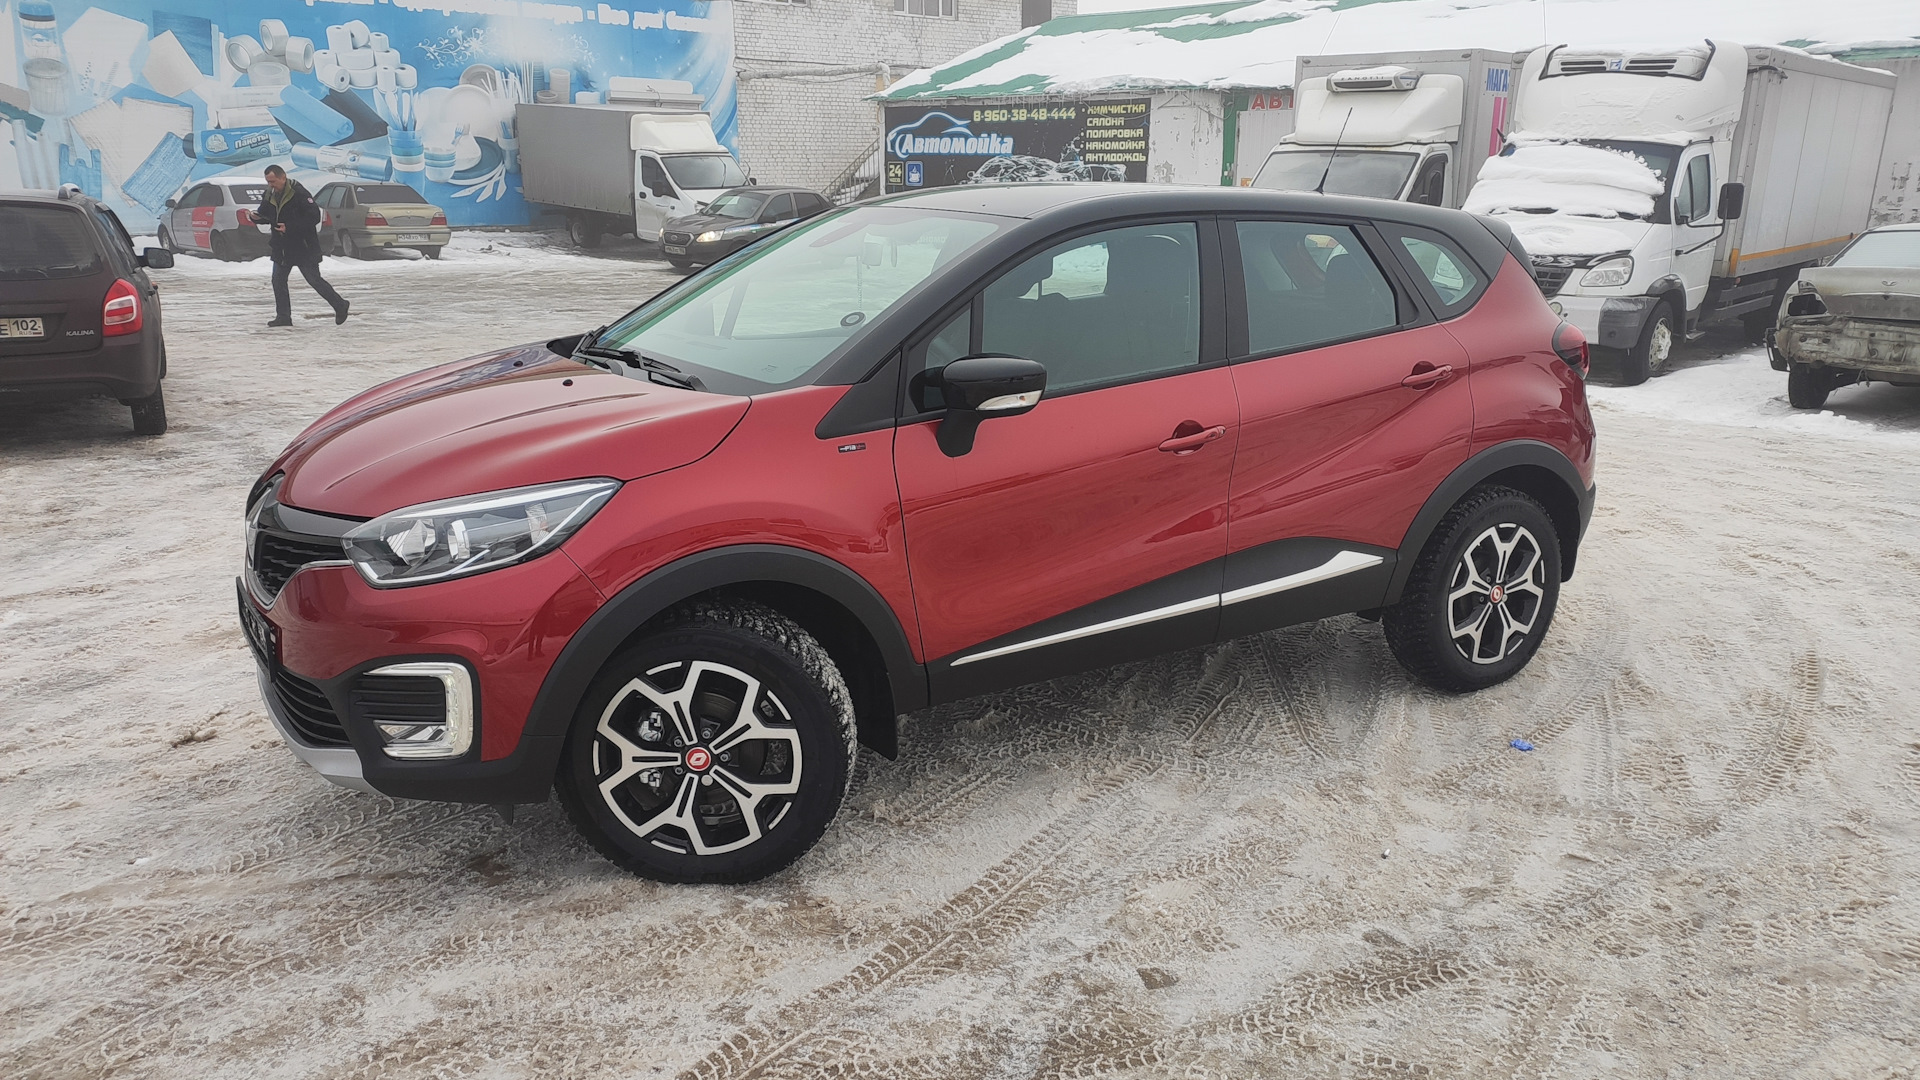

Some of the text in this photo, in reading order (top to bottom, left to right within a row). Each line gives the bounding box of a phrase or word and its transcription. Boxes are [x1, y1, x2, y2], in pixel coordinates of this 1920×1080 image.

[1485, 67, 1511, 92] МАГА
[973, 107, 1076, 121] 8-960-38-48-444
[1087, 104, 1146, 115] ХИМЧИСТКА
[1086, 117, 1125, 127] САЛОНА
[1086, 128, 1144, 139] ПОЛИРОВКА
[901, 132, 1014, 155] Автомойка
[1085, 139, 1146, 150] НАНОМОЙКА
[1085, 152, 1147, 162] АНТИДОЖДЬ
[889, 164, 902, 177] 24
[12, 319, 38, 331] 102
